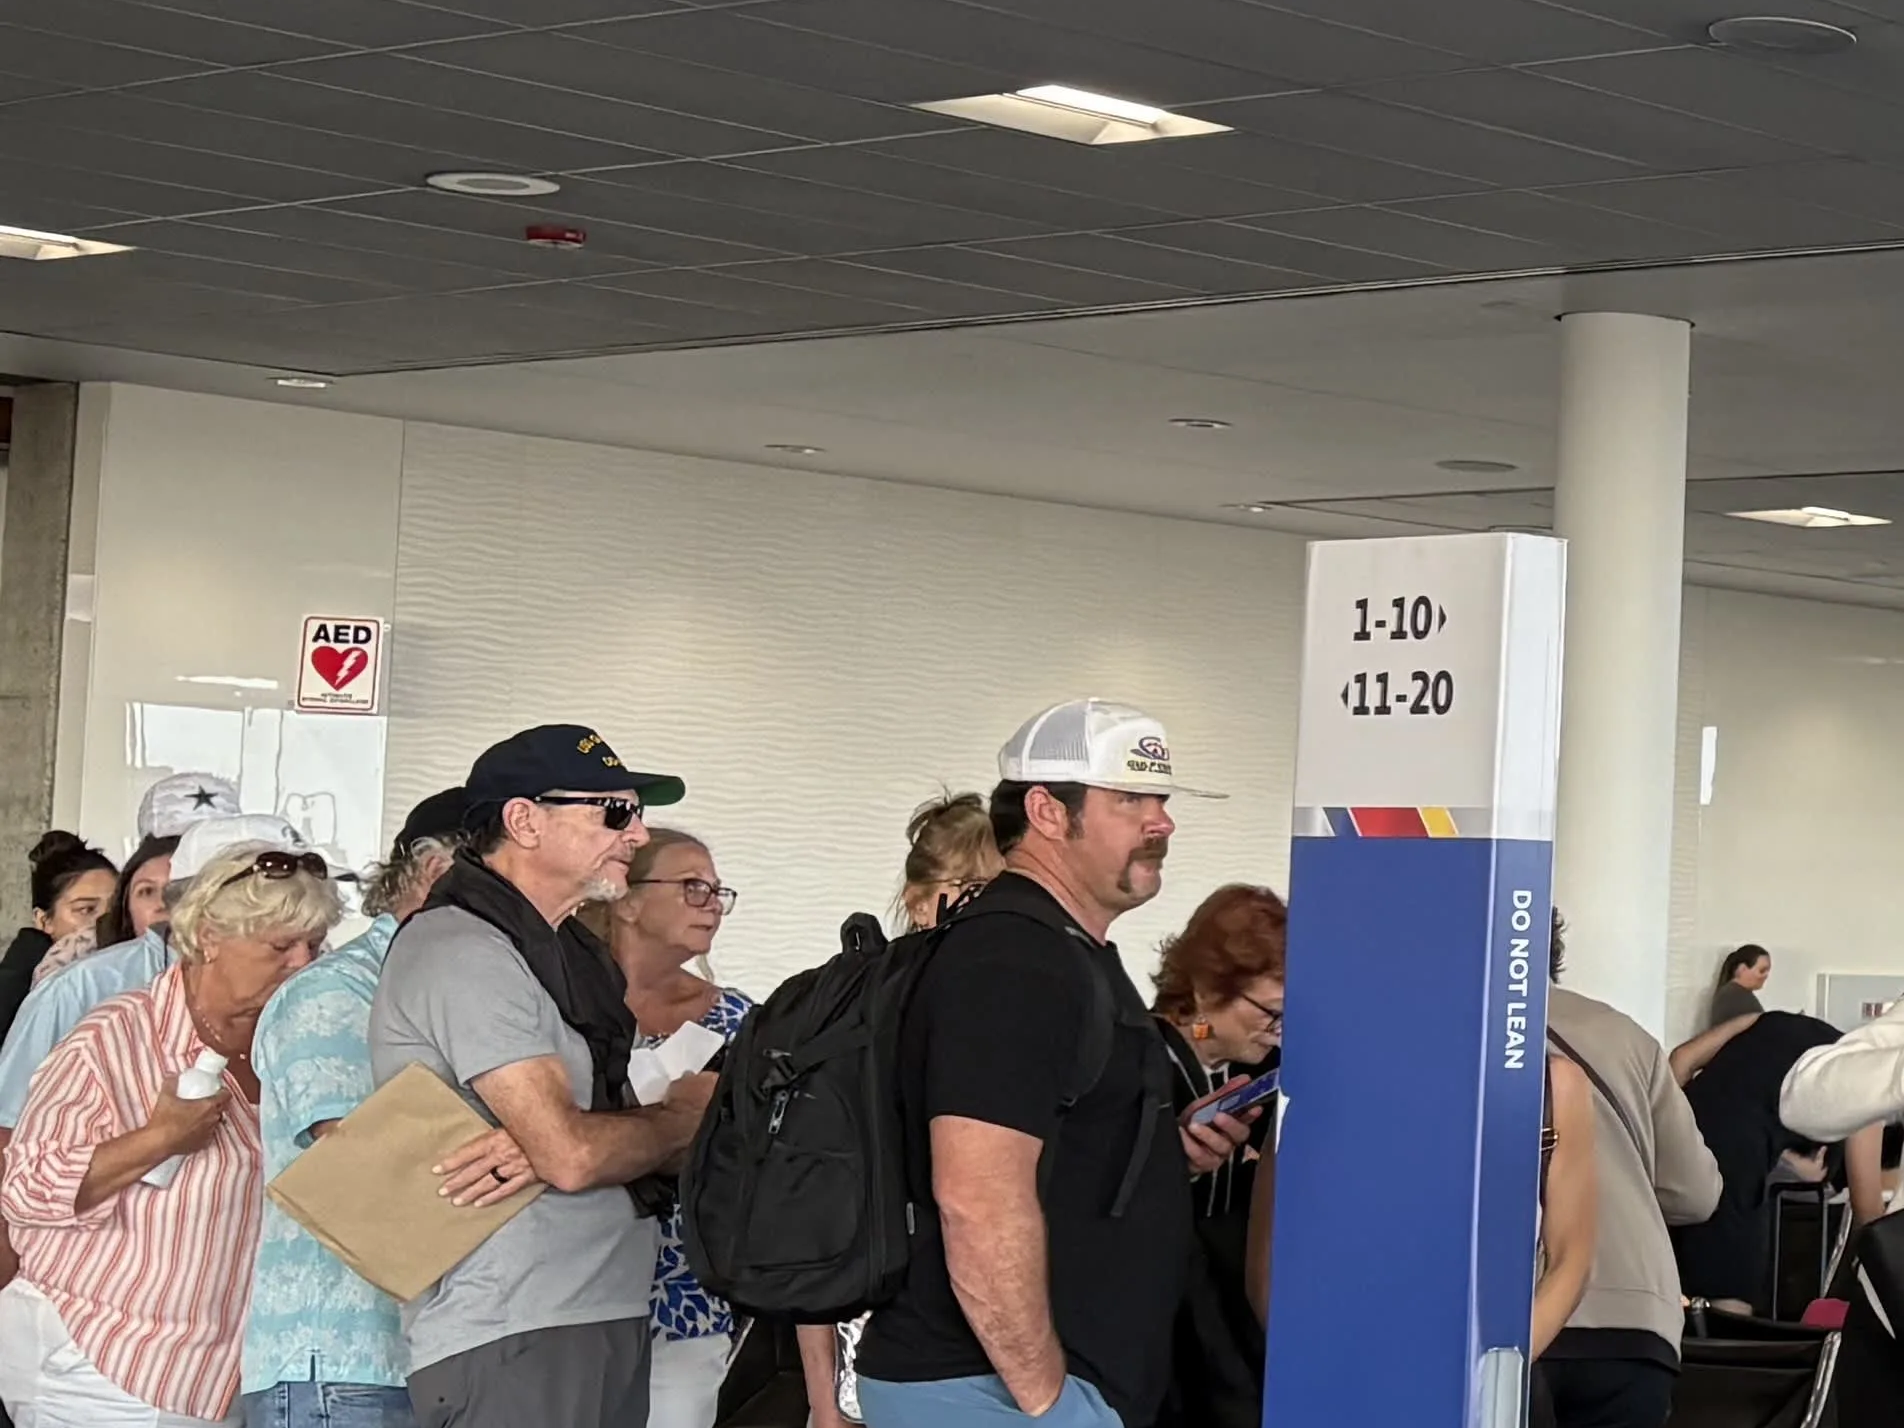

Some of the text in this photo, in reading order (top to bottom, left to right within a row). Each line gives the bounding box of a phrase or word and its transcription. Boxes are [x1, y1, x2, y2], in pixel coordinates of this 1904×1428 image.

[311, 623, 372, 645] AED
[1353, 595, 1433, 642] 1-10
[1352, 669, 1454, 716] 11-20
[1504, 890, 1532, 1069] DO NOT LEAN
